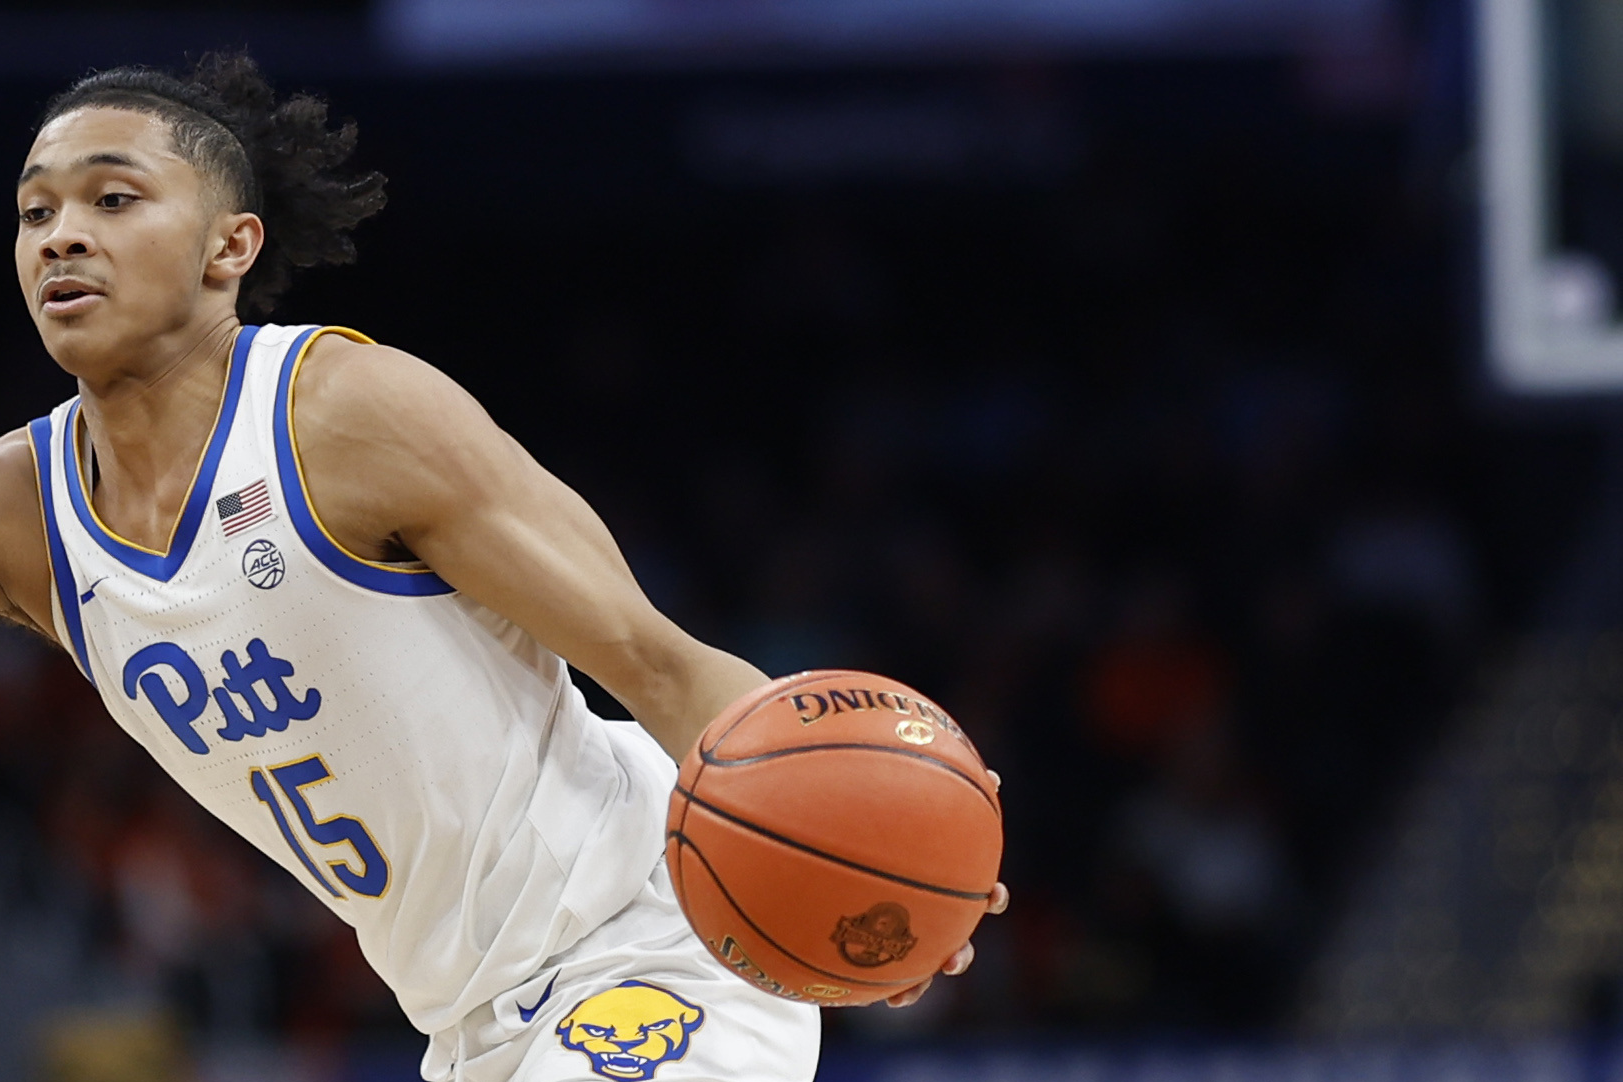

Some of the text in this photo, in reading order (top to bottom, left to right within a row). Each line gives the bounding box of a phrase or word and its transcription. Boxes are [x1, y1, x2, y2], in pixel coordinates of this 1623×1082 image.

[249, 548, 280, 573] ACC
[122, 637, 322, 755] Pitt
[249, 752, 392, 901] 15
